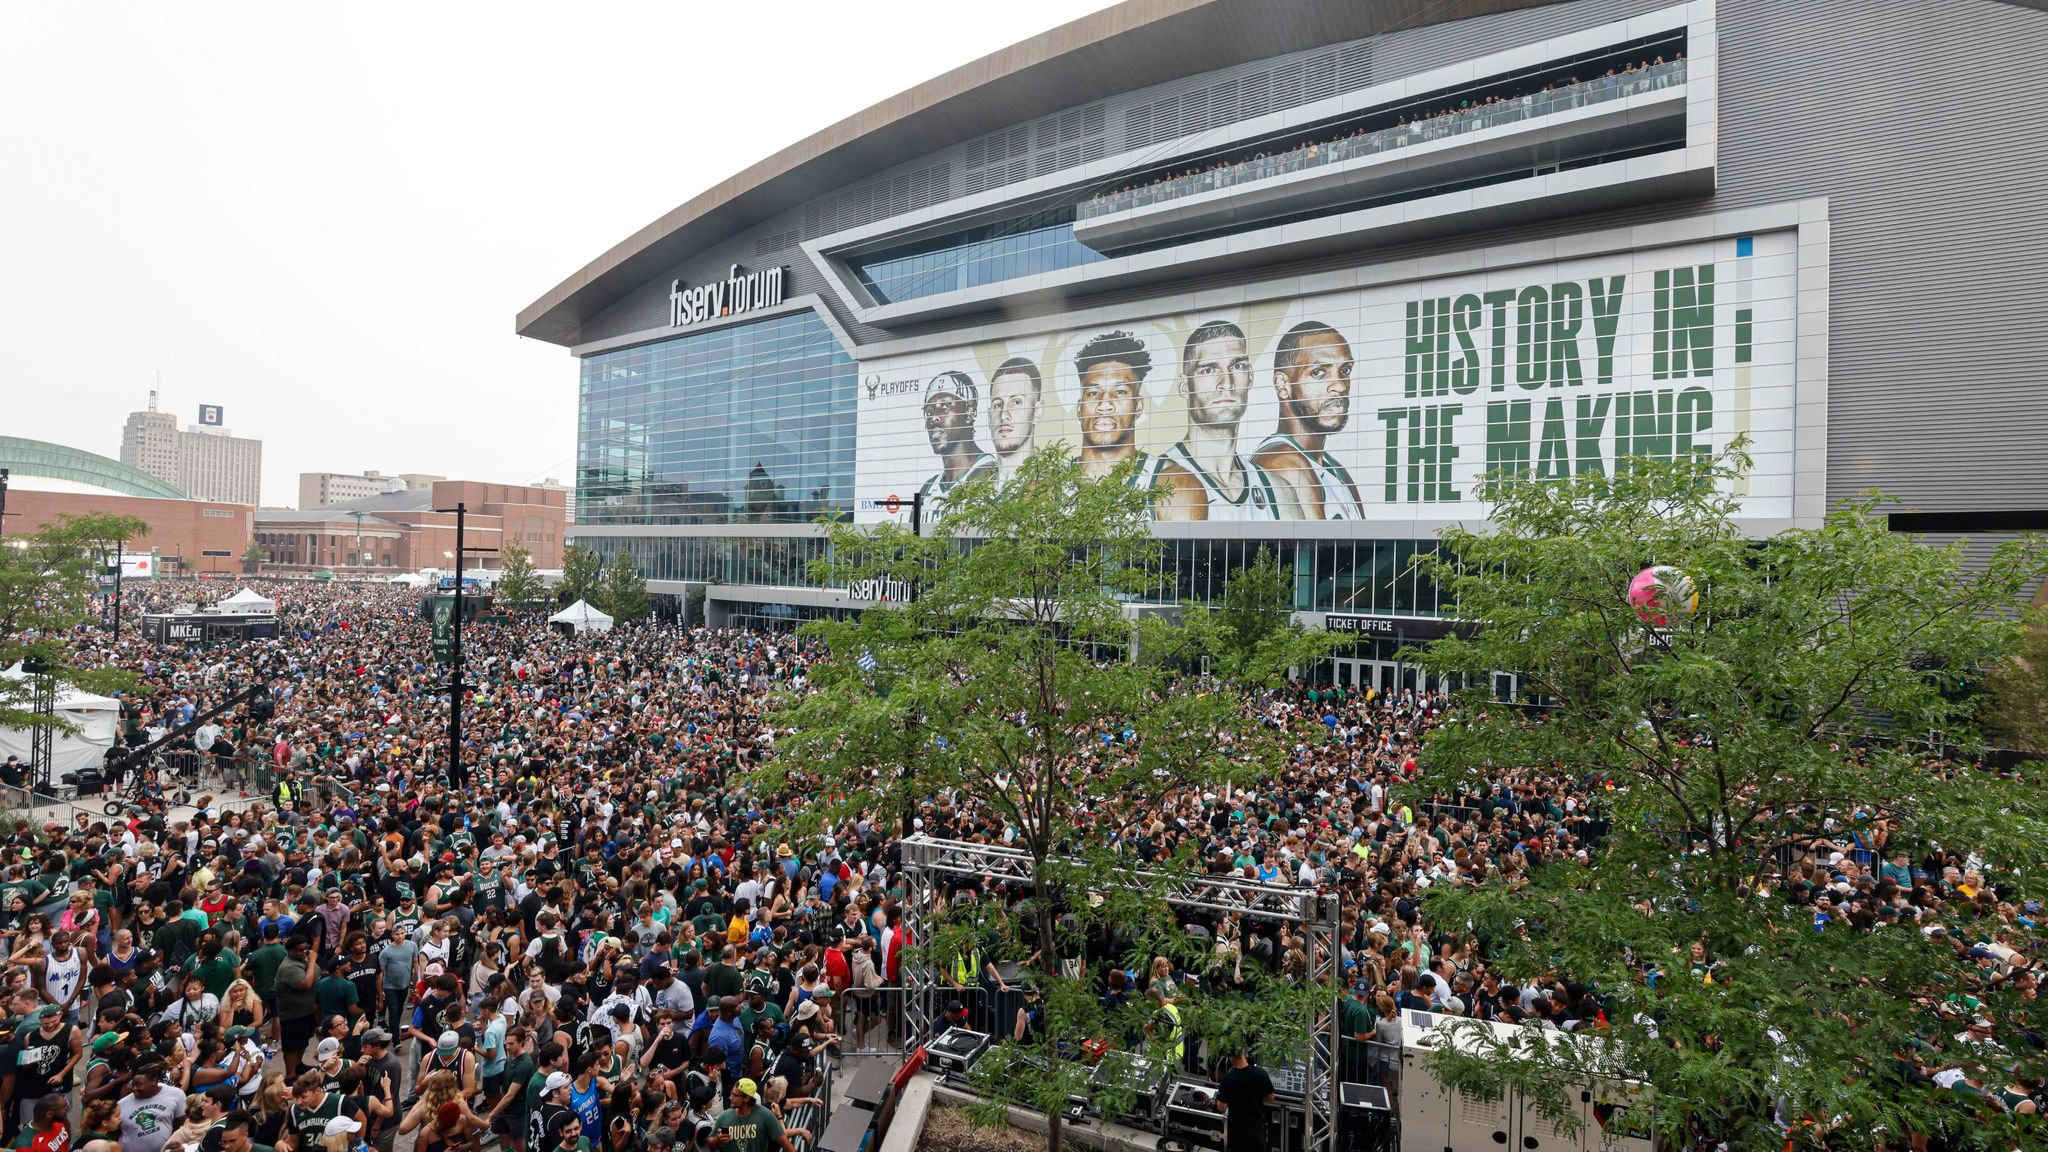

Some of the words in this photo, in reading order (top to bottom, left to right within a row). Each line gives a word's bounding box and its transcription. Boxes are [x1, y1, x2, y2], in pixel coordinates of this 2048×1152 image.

[1404, 275, 1627, 399] HISTORY
[1651, 264, 1715, 381] IN
[880, 379, 919, 396] PLAYOFFS
[1377, 403, 1464, 505] THE
[1328, 617, 1358, 629] TICKET
[1361, 619, 1392, 632] OFFICE
[480, 879, 499, 891] BUCKS
[486, 888, 497, 900] 22
[61, 983, 69, 996] 1
[585, 1105, 600, 1125] 22
[47, 1126, 69, 1152] BUCKS
[729, 1123, 757, 1141] BUCKS
